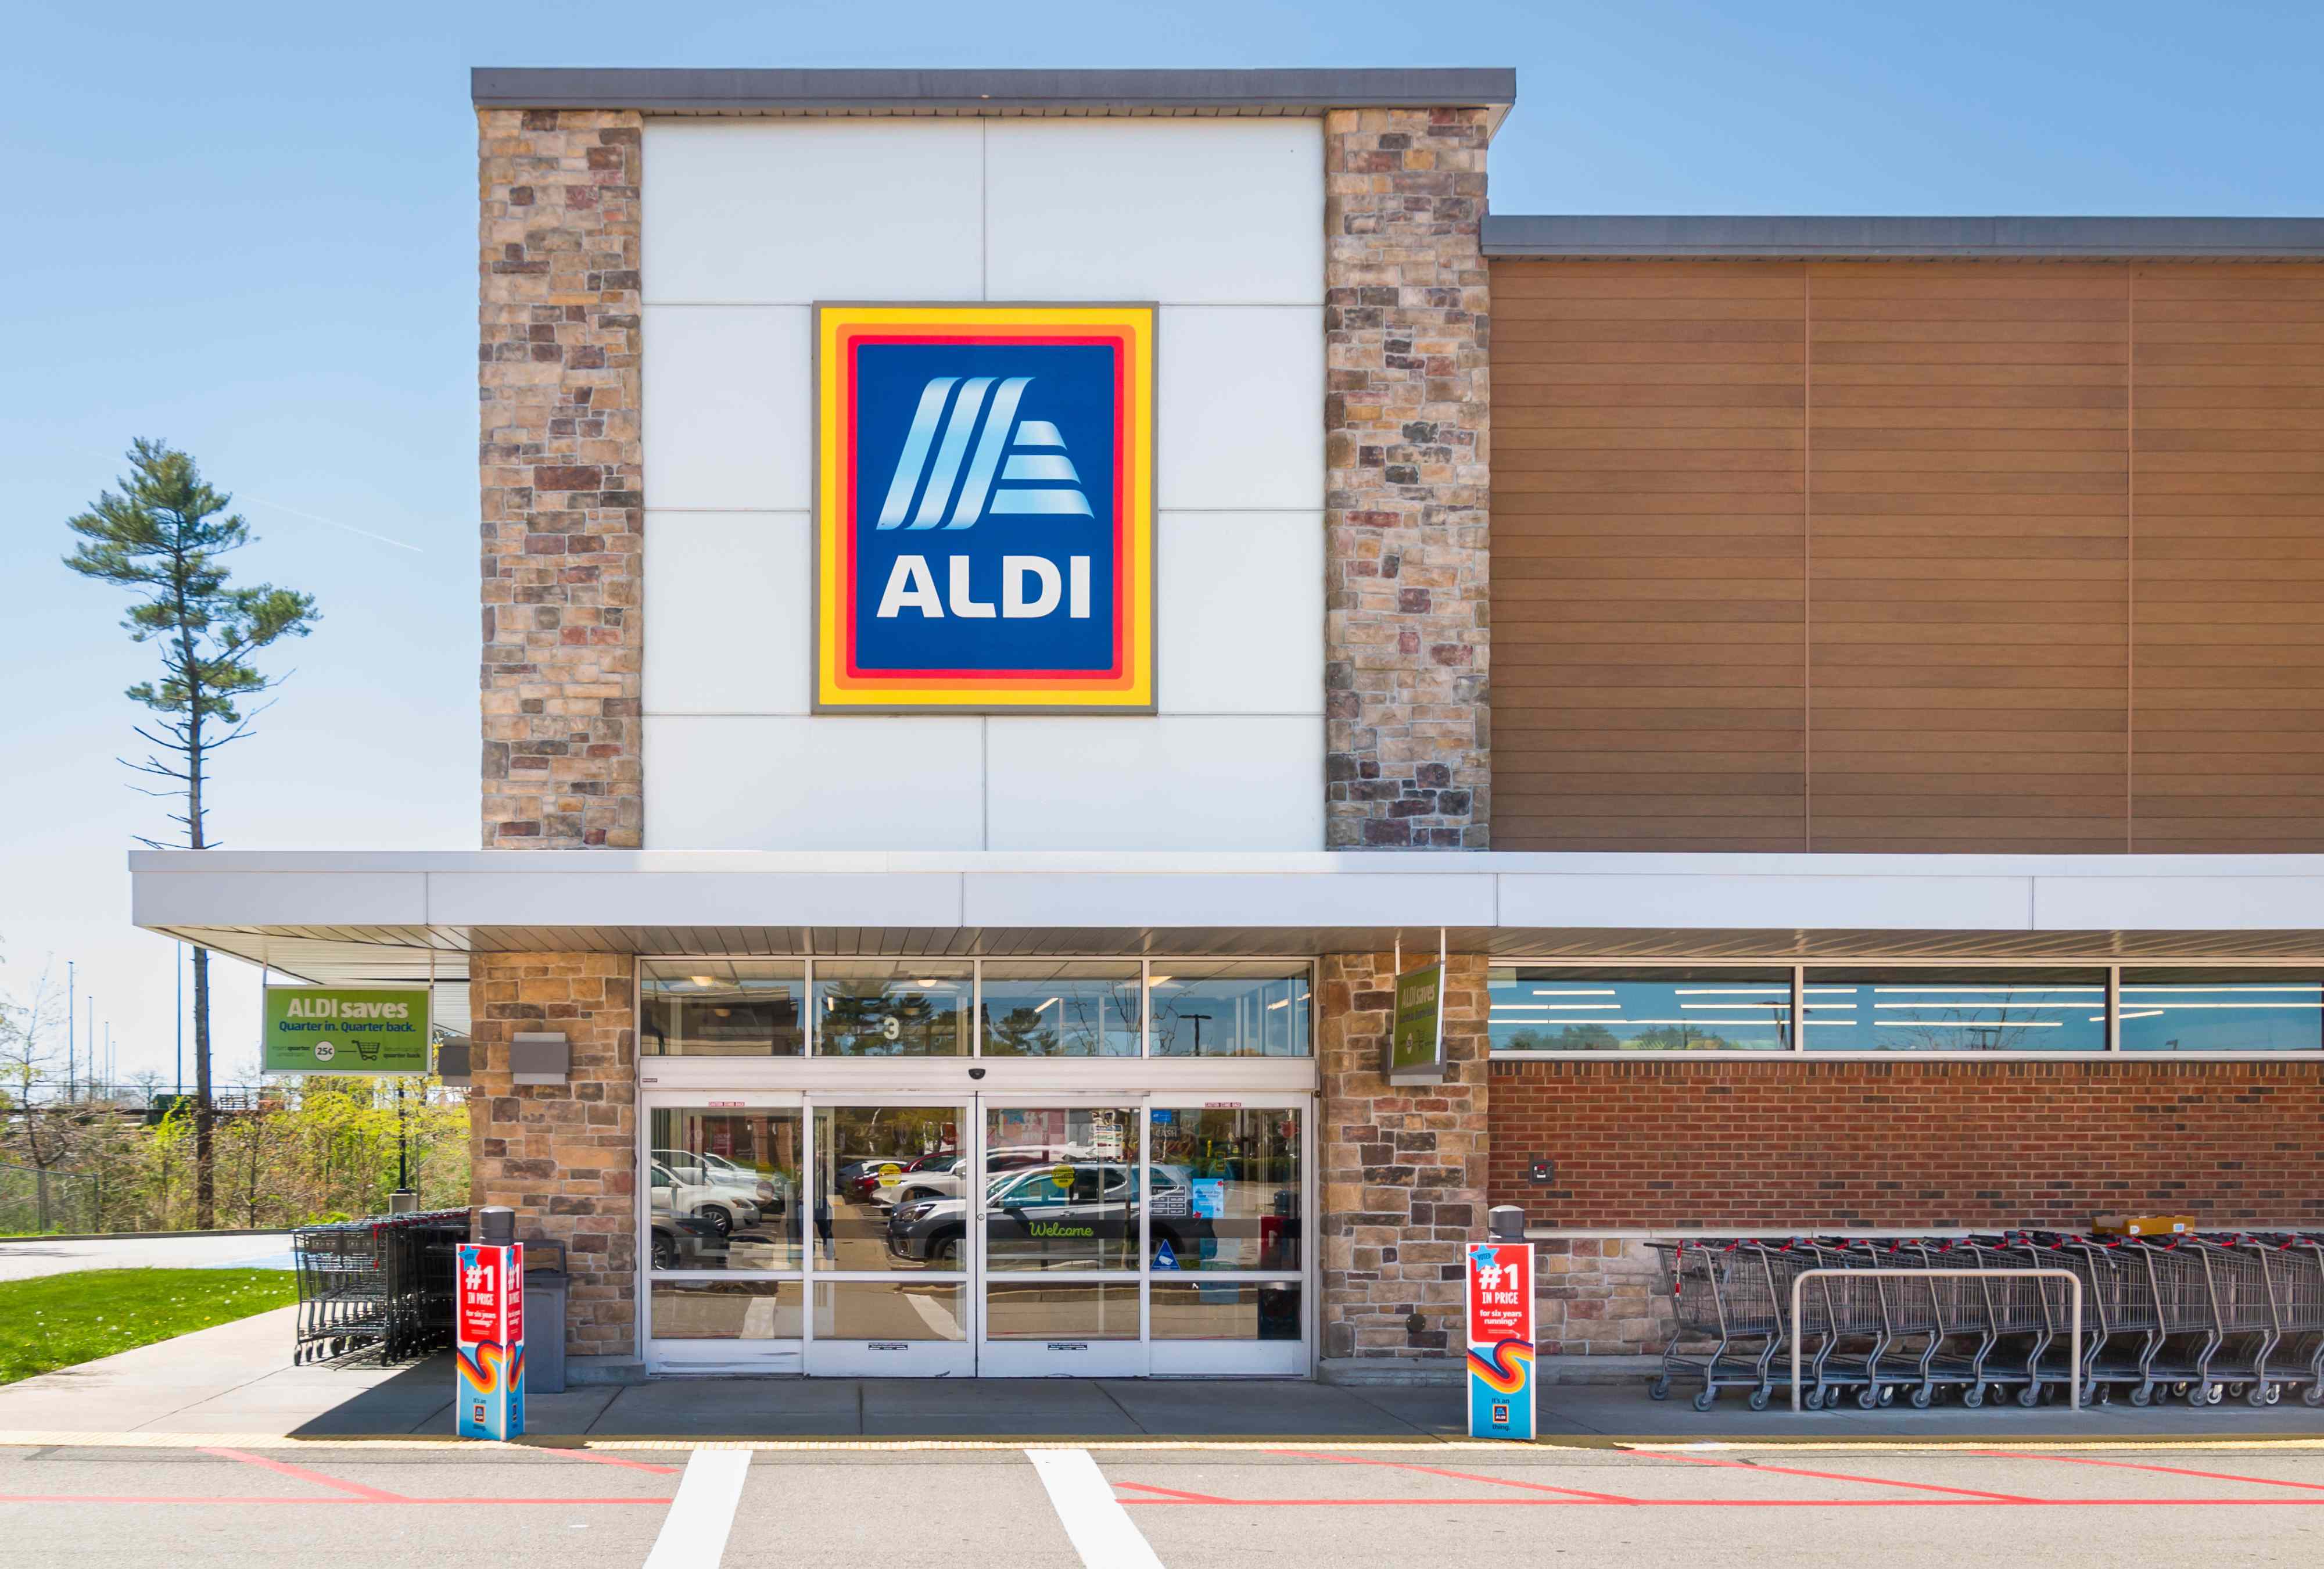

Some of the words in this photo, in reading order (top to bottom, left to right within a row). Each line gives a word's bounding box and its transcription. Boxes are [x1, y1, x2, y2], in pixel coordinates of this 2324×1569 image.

[877, 555, 1090, 618] ALDI
[287, 998, 338, 1017] ALDI
[340, 1002, 408, 1018] saves
[1401, 986, 1416, 1009] ALDI
[279, 1021, 322, 1032] Quarter
[325, 1020, 338, 1031] in.
[340, 1022, 383, 1033] Quarter
[386, 1022, 416, 1032] back.
[884, 1017, 899, 1040] 3
[1029, 1222, 1094, 1236] Welcome
[465, 1264, 493, 1291] #1
[1479, 1263, 1518, 1290] #1
[467, 1292, 475, 1304] IN
[476, 1292, 494, 1306] PRICE
[1482, 1292, 1492, 1304] IN
[1495, 1292, 1518, 1304] PRICE
